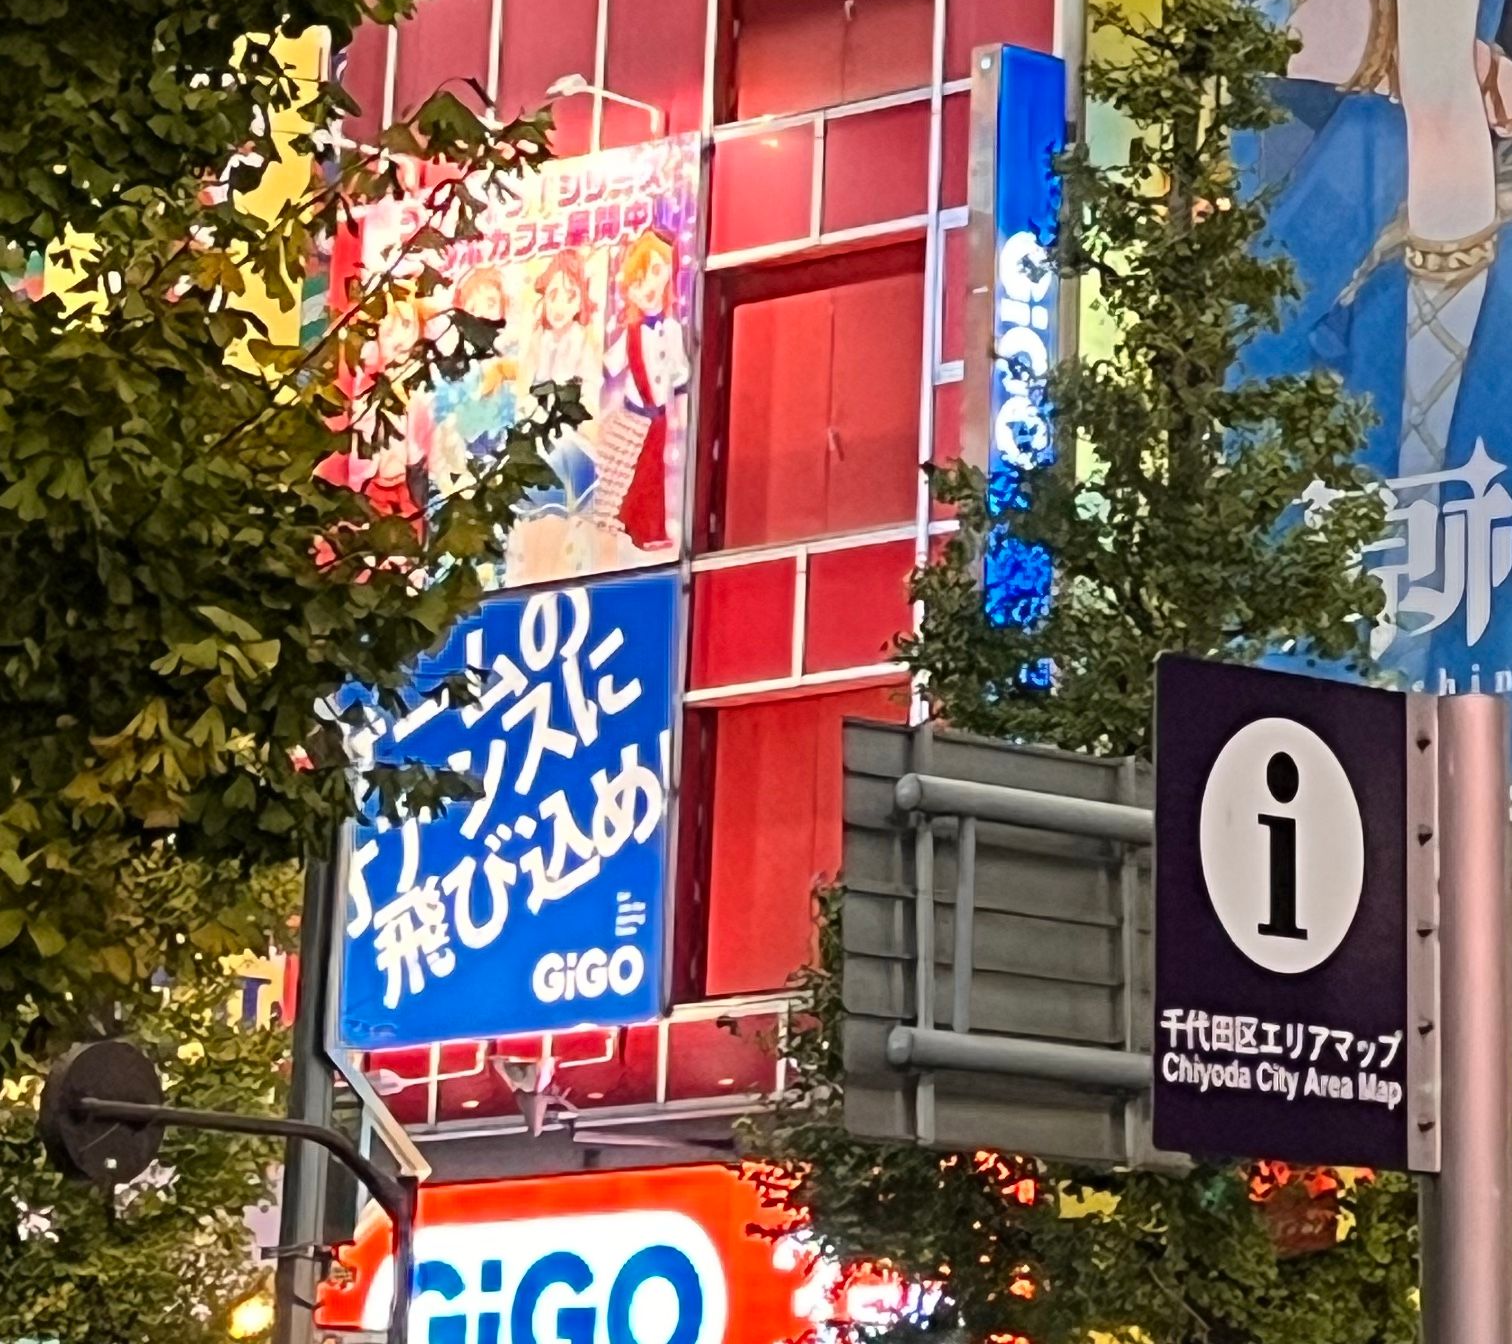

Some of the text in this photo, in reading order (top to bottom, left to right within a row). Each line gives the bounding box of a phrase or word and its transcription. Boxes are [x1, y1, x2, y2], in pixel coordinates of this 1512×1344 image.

[532, 944, 646, 1004] GiGO
[1160, 1008, 1404, 1068] 千代田区エリアマップ
[1162, 1051, 1403, 1111] Chiyoda City Area Map
